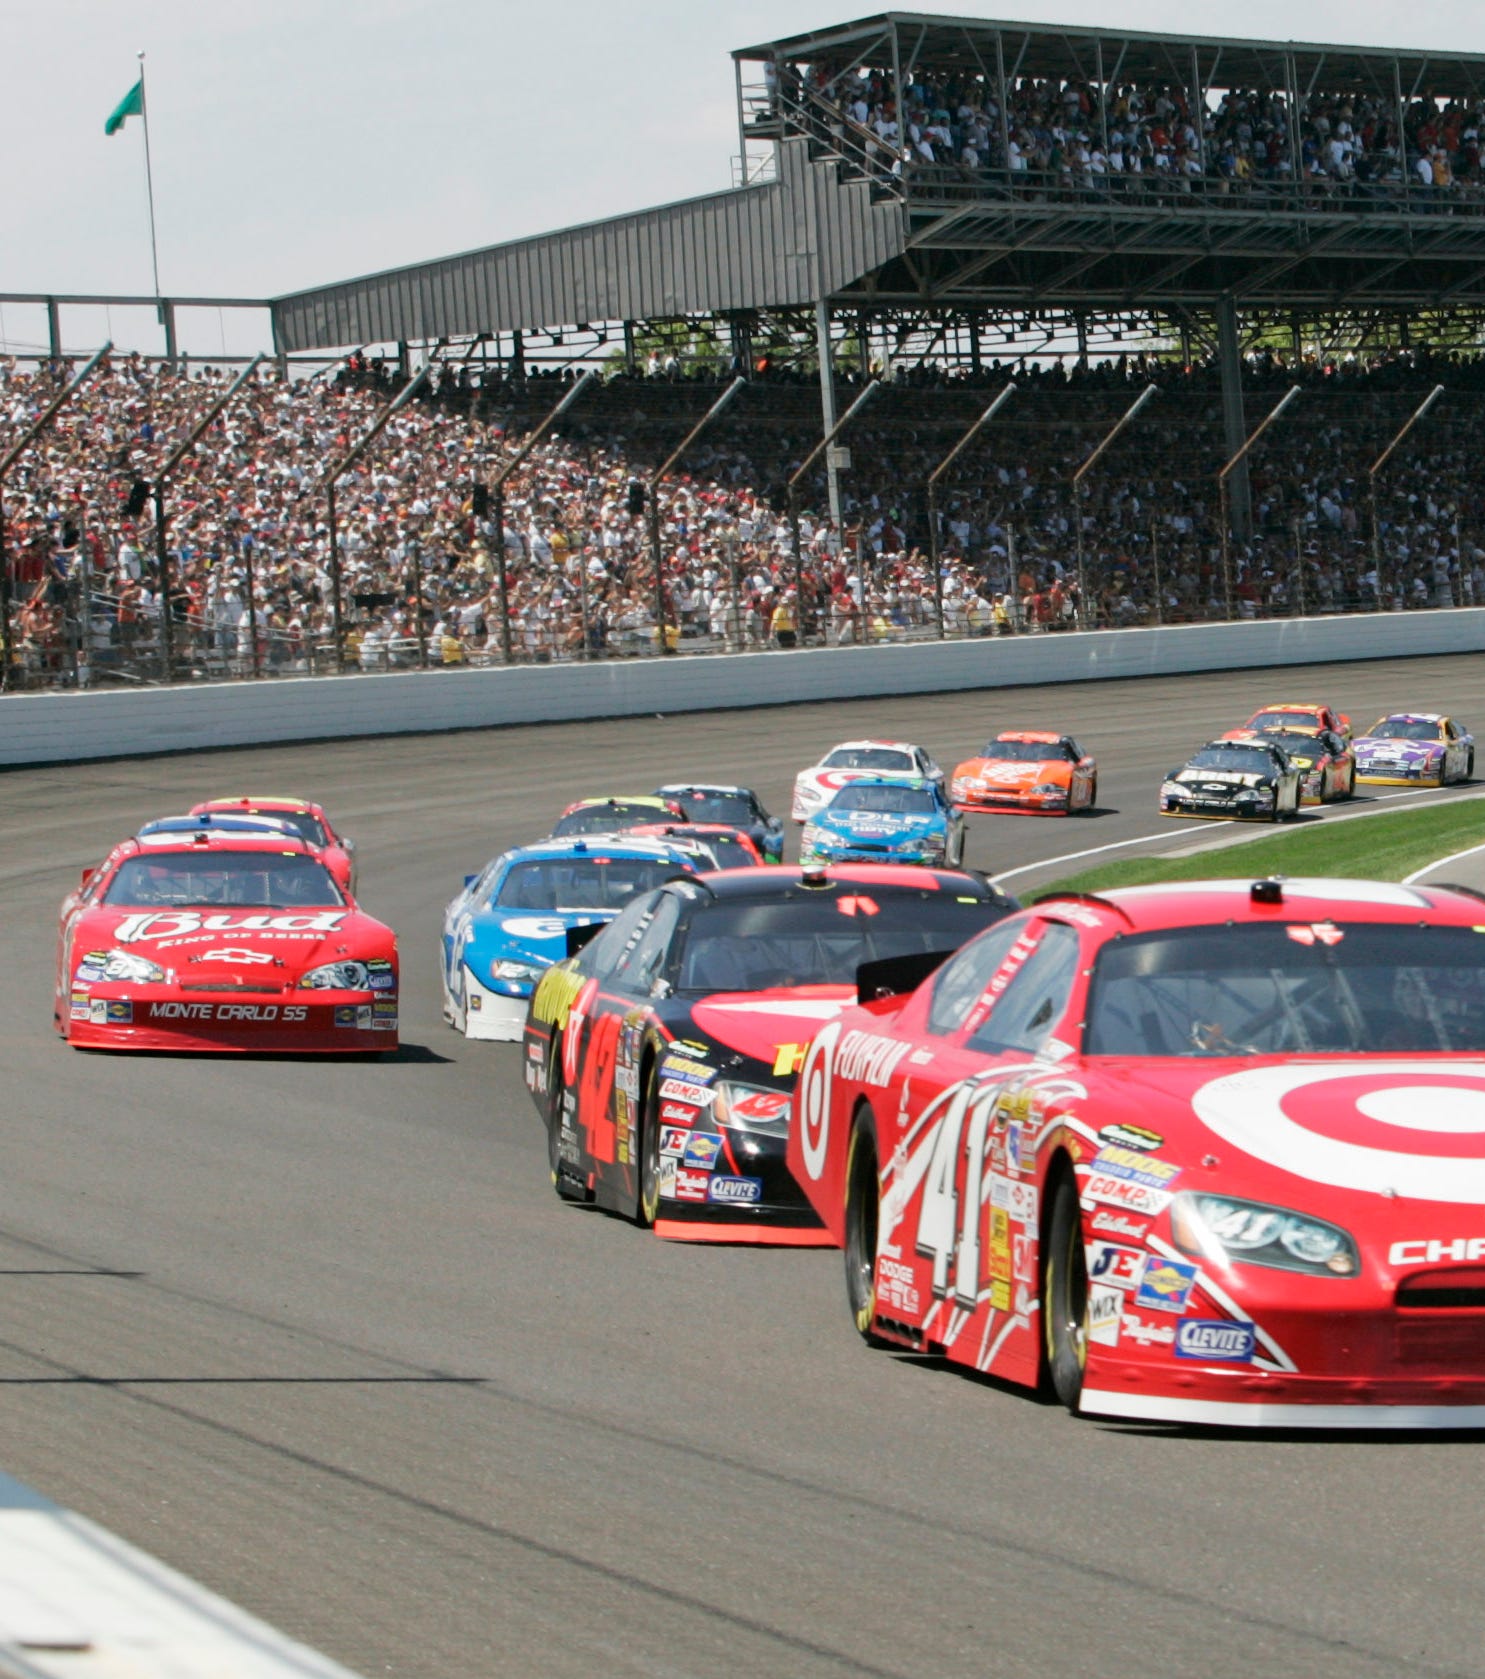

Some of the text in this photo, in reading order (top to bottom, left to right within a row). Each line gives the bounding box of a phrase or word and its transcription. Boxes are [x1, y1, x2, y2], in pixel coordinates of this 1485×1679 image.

[113, 911, 347, 944] Bud
[150, 1002, 309, 1021] MONTE CARLO SS
[1090, 1177, 1147, 1201] COMP
[1212, 1209, 1276, 1241] 41
[1179, 1321, 1247, 1351] CLEVITE
